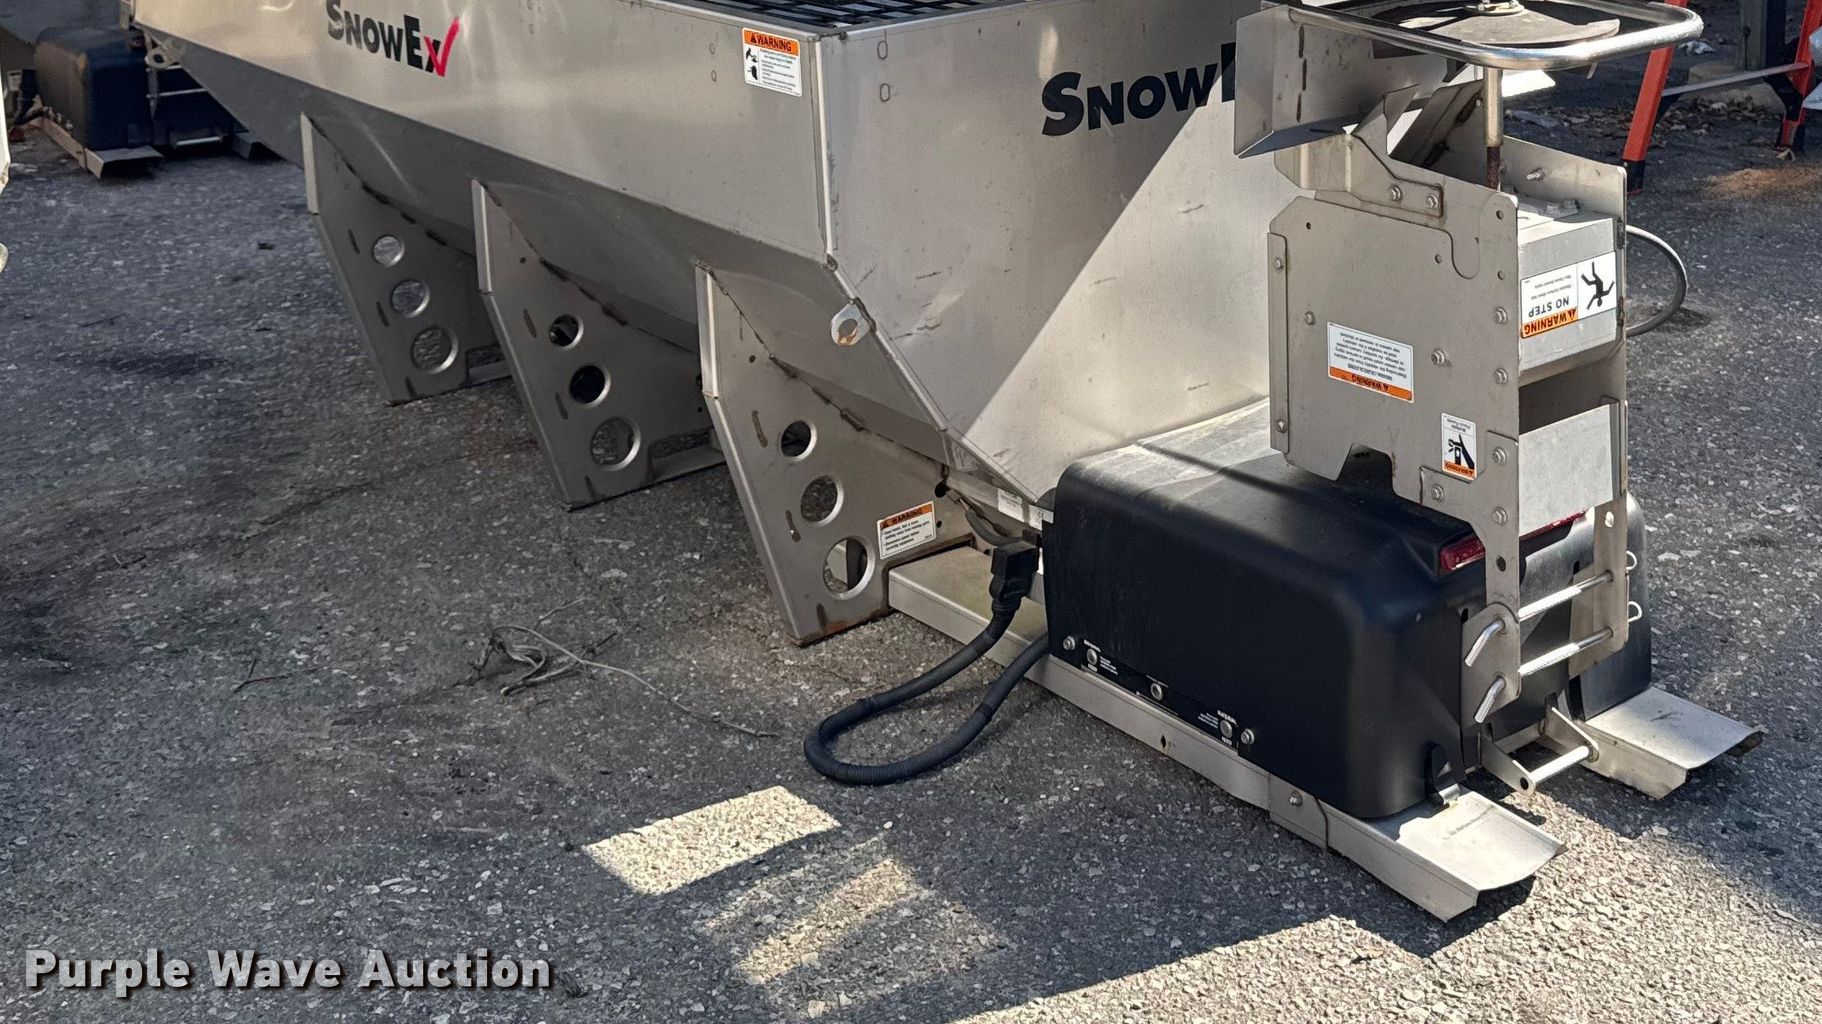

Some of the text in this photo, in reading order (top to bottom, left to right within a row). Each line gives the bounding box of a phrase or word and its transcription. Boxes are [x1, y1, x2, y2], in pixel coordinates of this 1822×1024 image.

[757, 34, 791, 52] WARNING
[1529, 296, 1569, 317] NO STEP
[1524, 312, 1567, 334] WARNING
